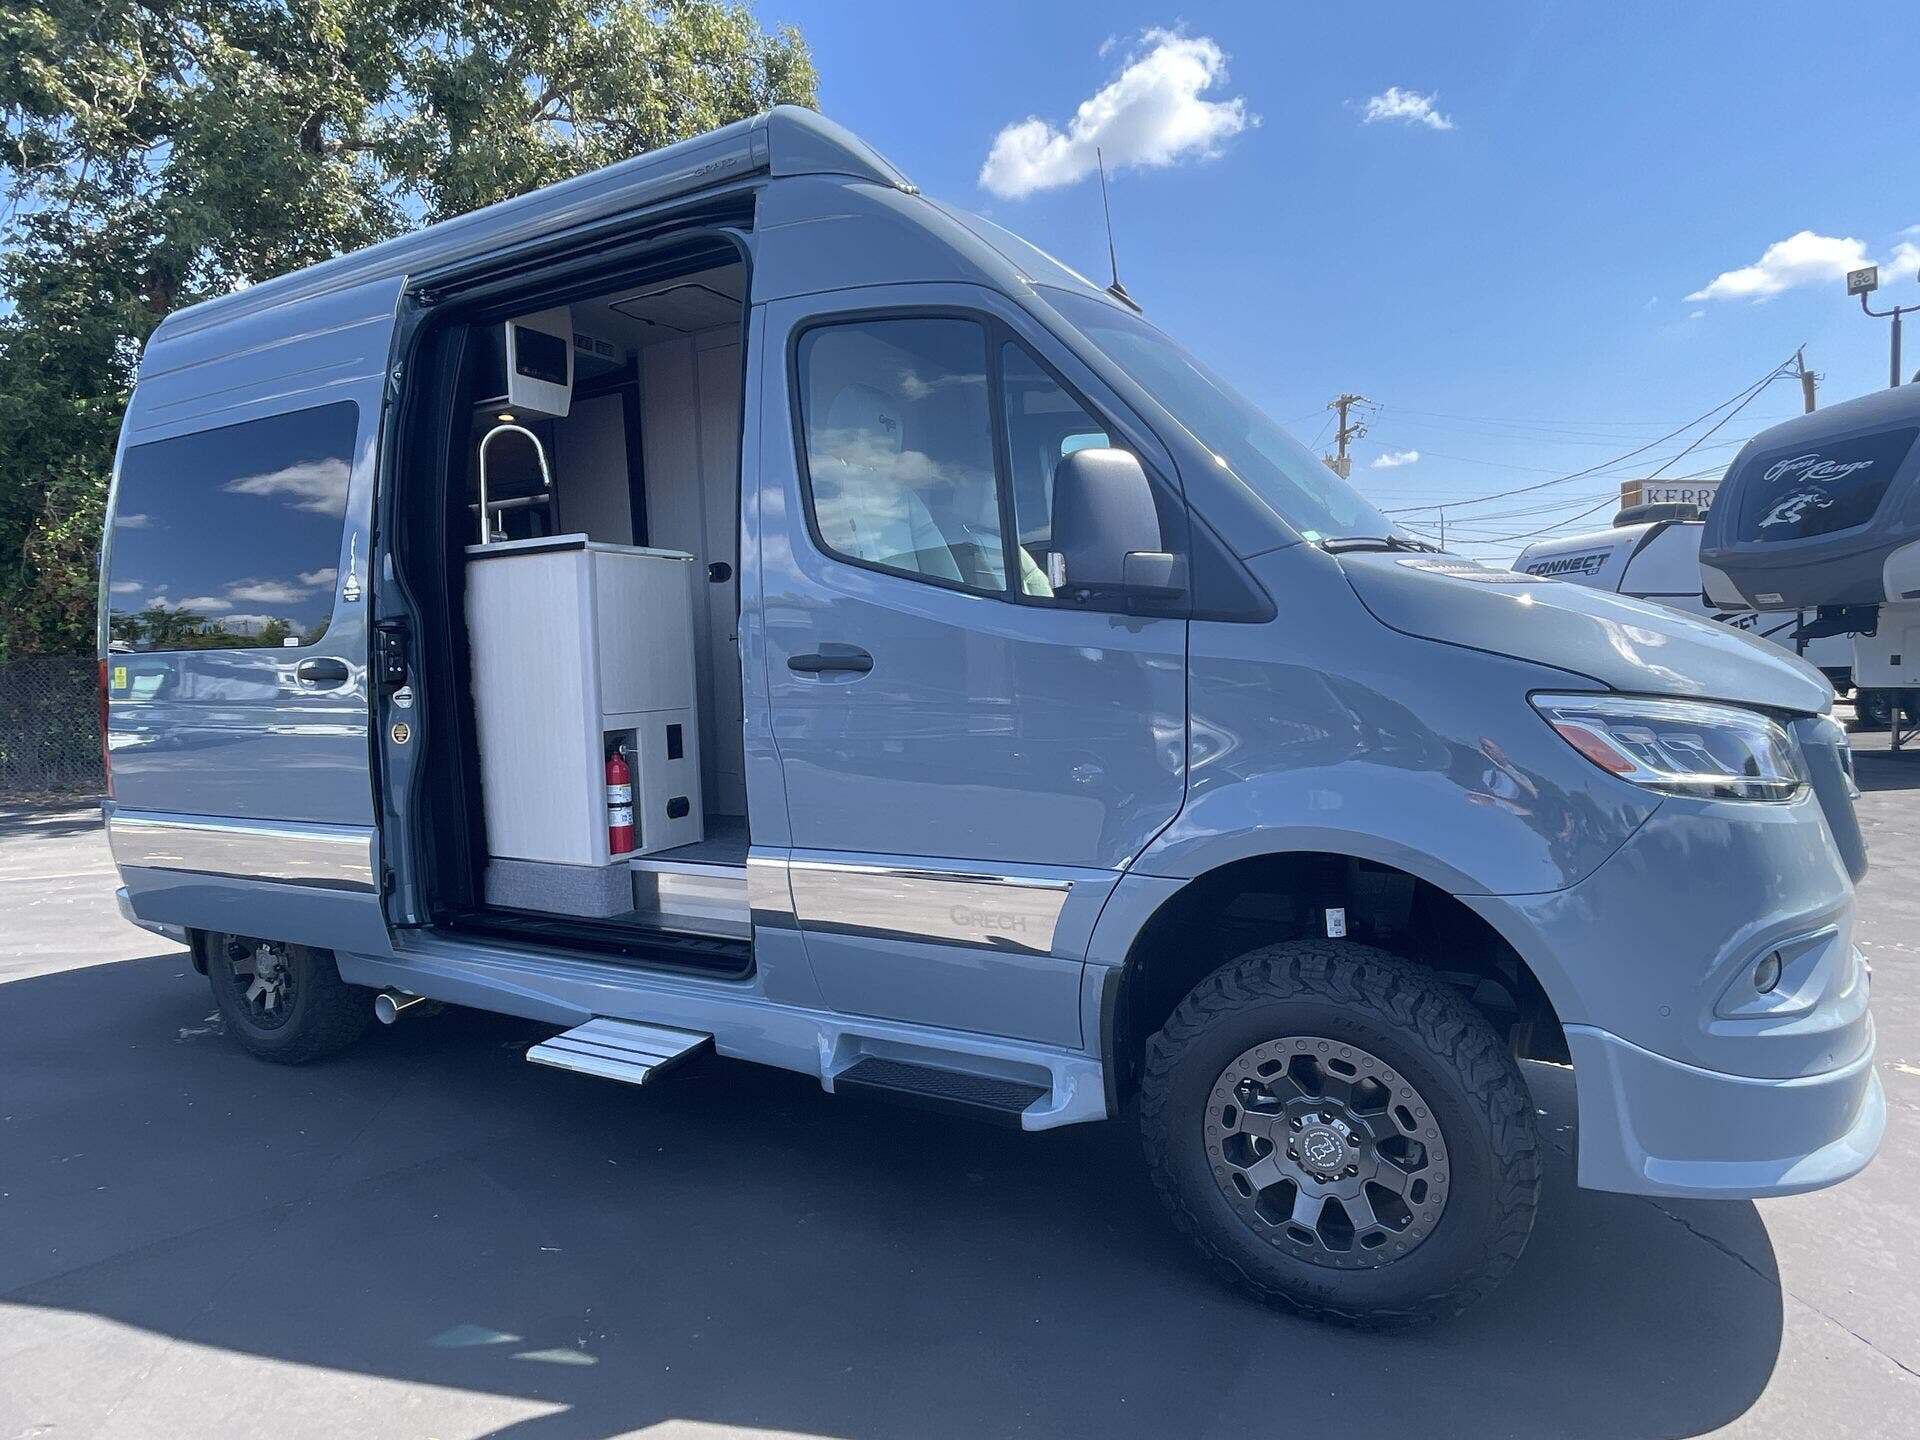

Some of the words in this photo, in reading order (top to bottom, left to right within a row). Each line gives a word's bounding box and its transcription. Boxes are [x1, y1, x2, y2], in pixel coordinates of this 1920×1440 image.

[1763, 453, 1820, 481] Open
[1796, 460, 1874, 481] Range
[1525, 553, 1611, 575] CONNECT
[950, 904, 1027, 932] GRECH
